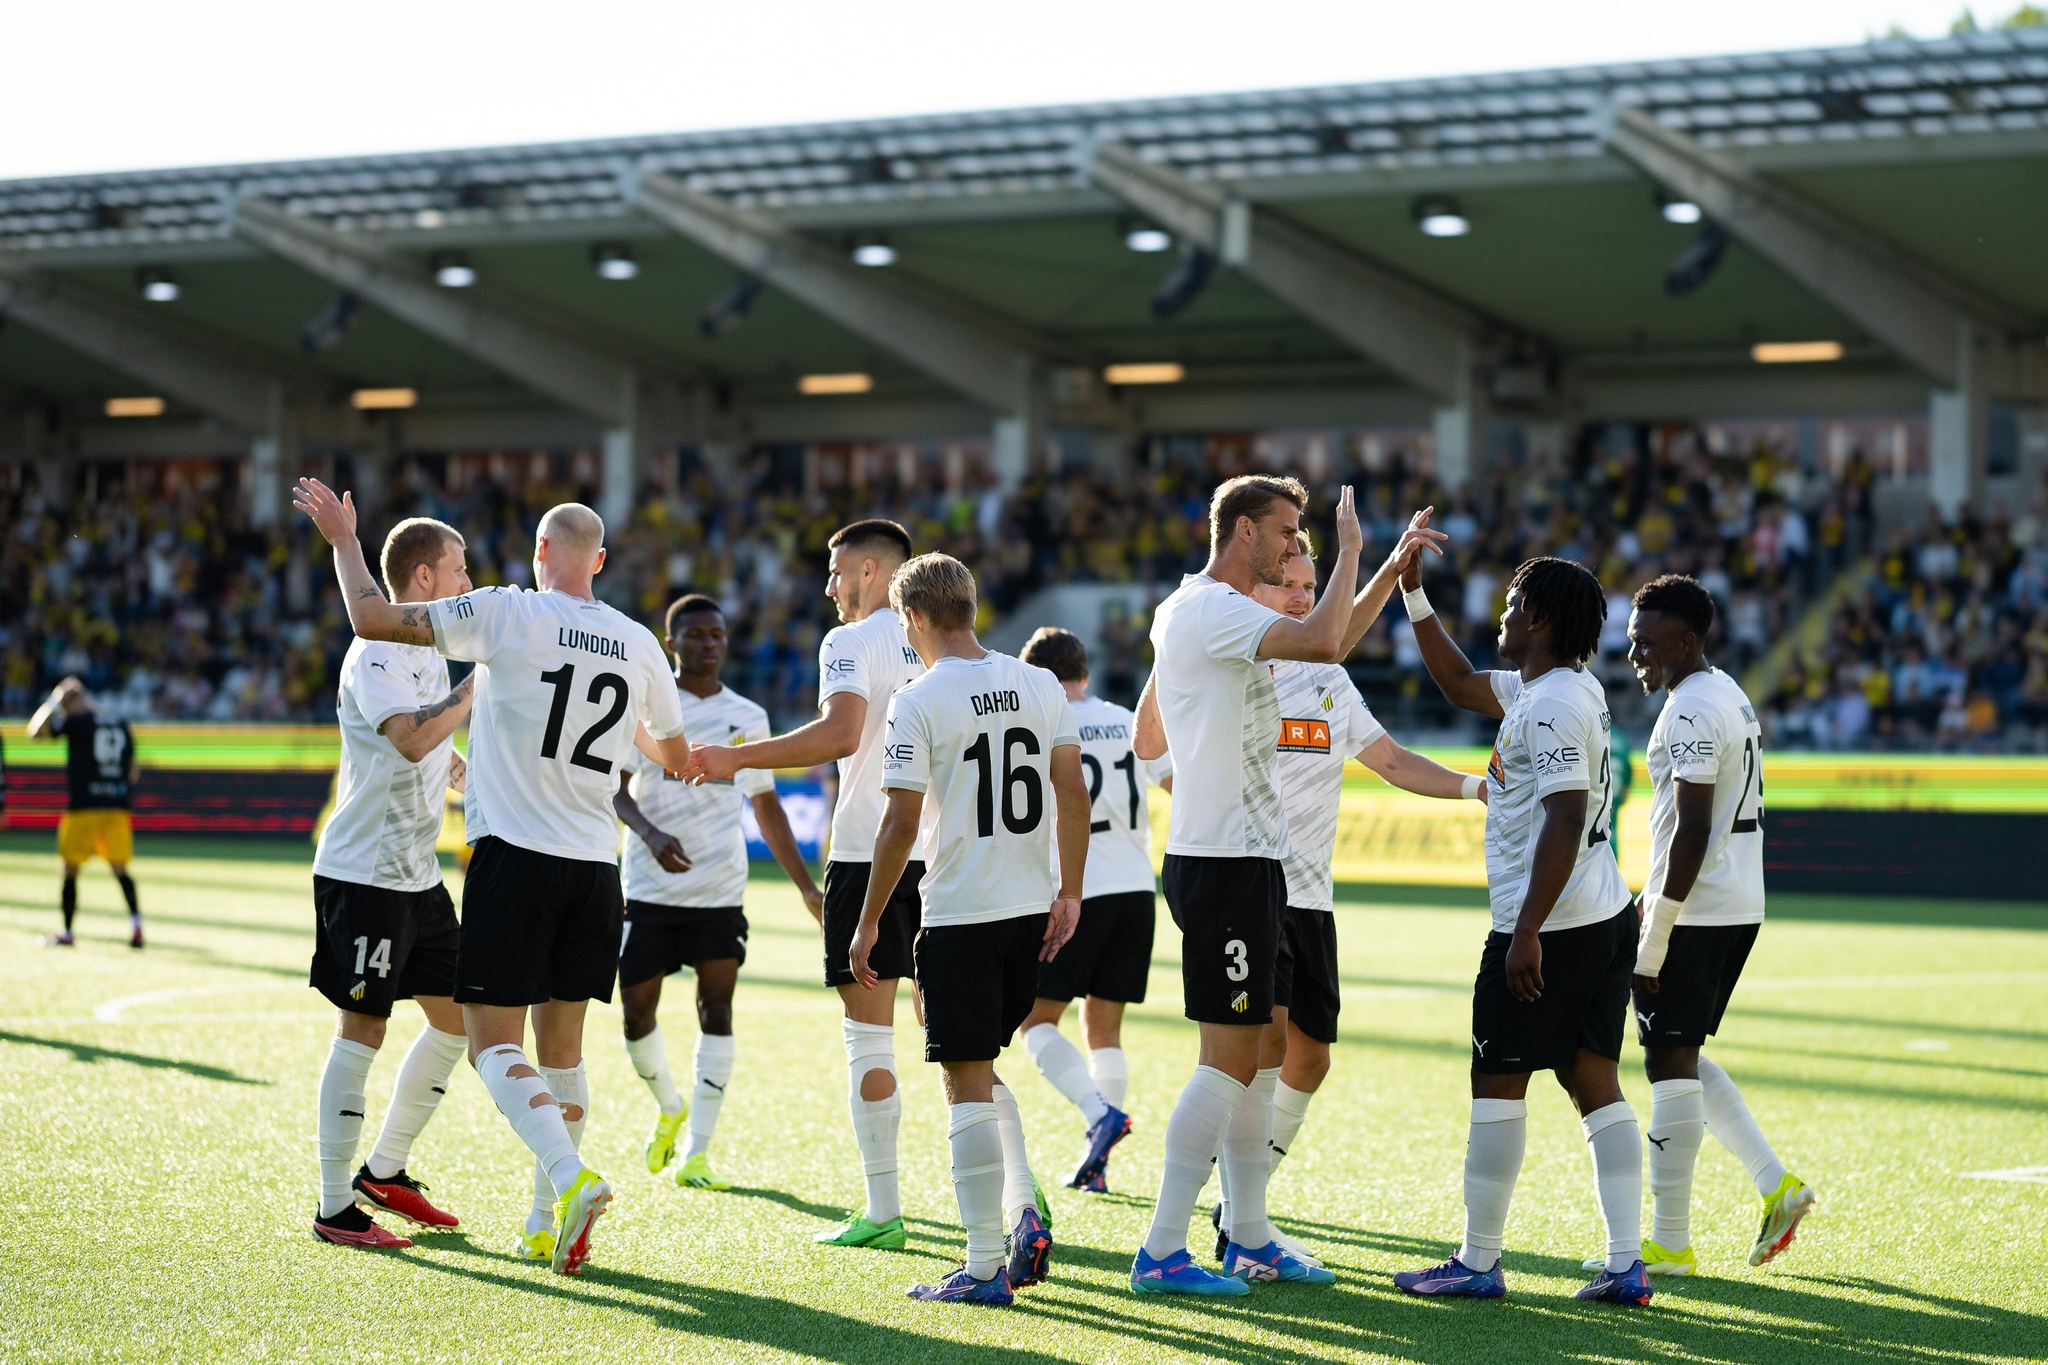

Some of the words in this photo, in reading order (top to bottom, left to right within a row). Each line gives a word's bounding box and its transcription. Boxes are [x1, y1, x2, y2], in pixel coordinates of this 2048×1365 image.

[559, 627, 628, 662] LUNDDAL
[540, 663, 629, 775] 12
[970, 690, 1020, 716] DAHBO
[1538, 747, 1580, 770] EXE
[1670, 741, 1714, 759] EXE
[963, 727, 1043, 838] 16
[1081, 751, 1140, 834] 21
[353, 935, 392, 978] 14
[1225, 939, 1249, 981] 3
